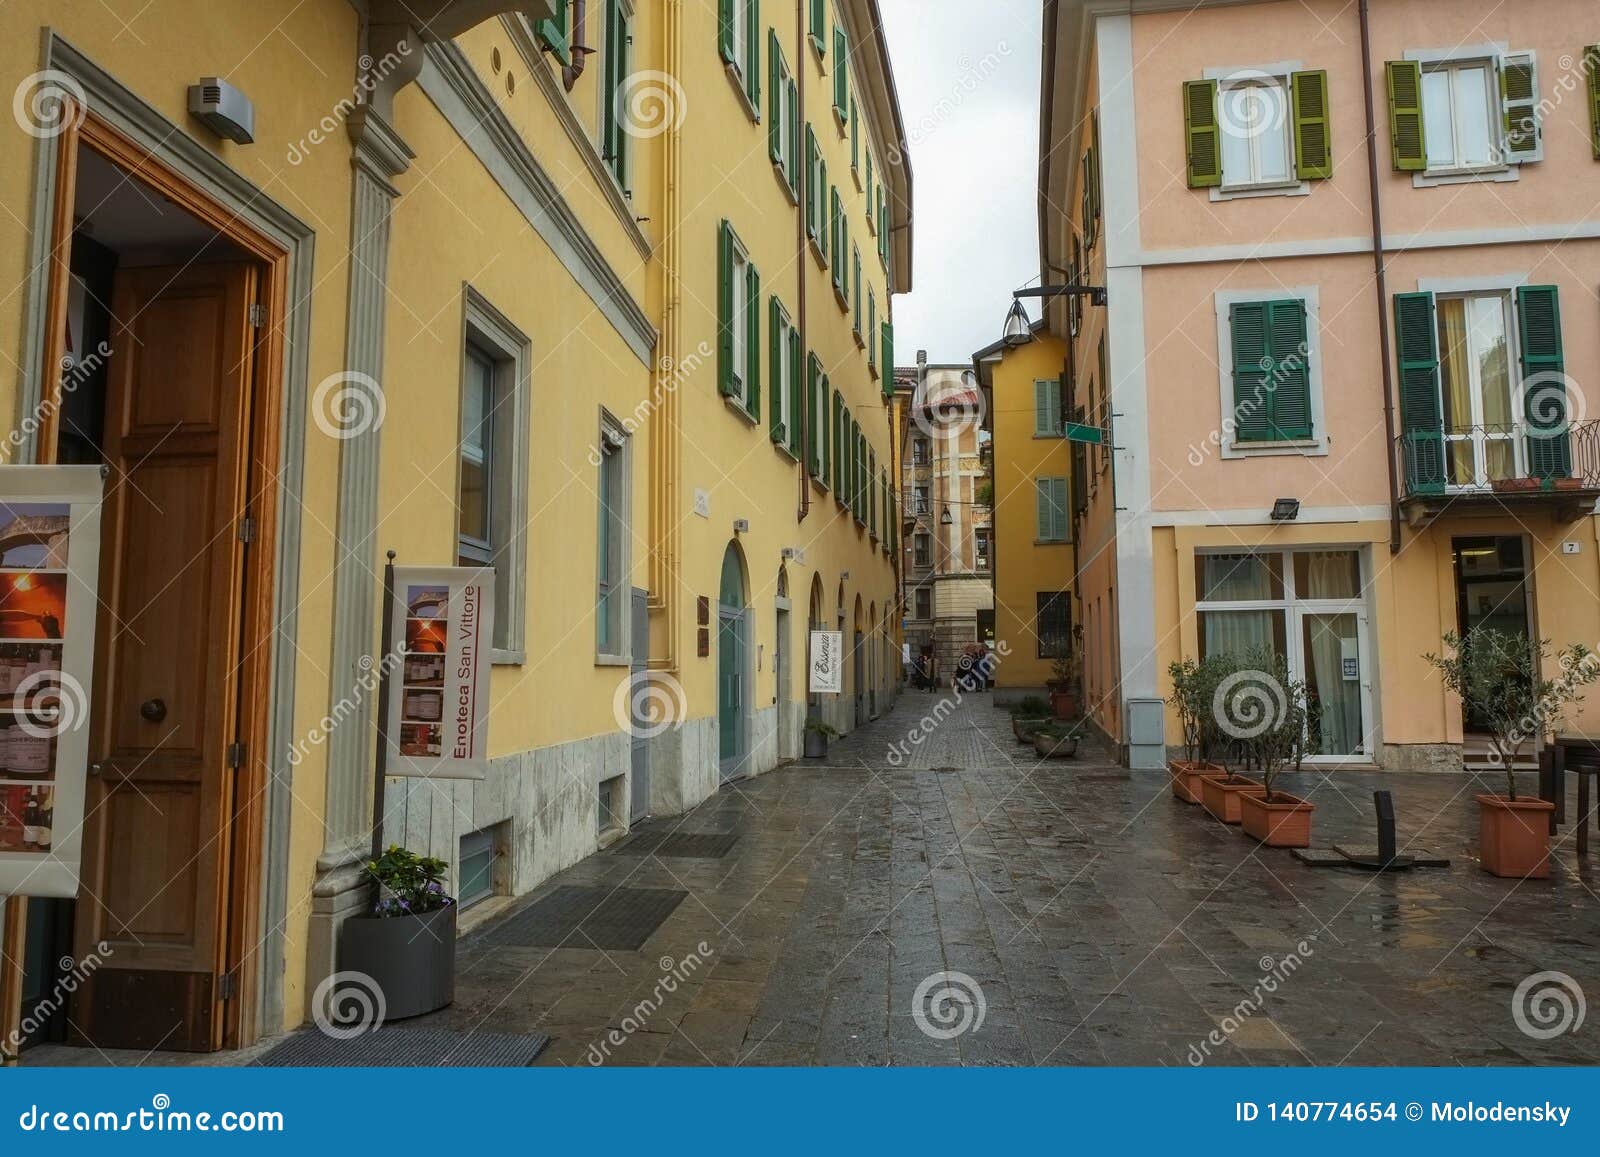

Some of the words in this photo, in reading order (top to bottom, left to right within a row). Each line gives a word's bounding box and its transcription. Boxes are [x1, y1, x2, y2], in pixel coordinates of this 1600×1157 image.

[460, 585, 475, 639] Vittore
[458, 645, 471, 678] San
[453, 685, 470, 759] Enoteca
